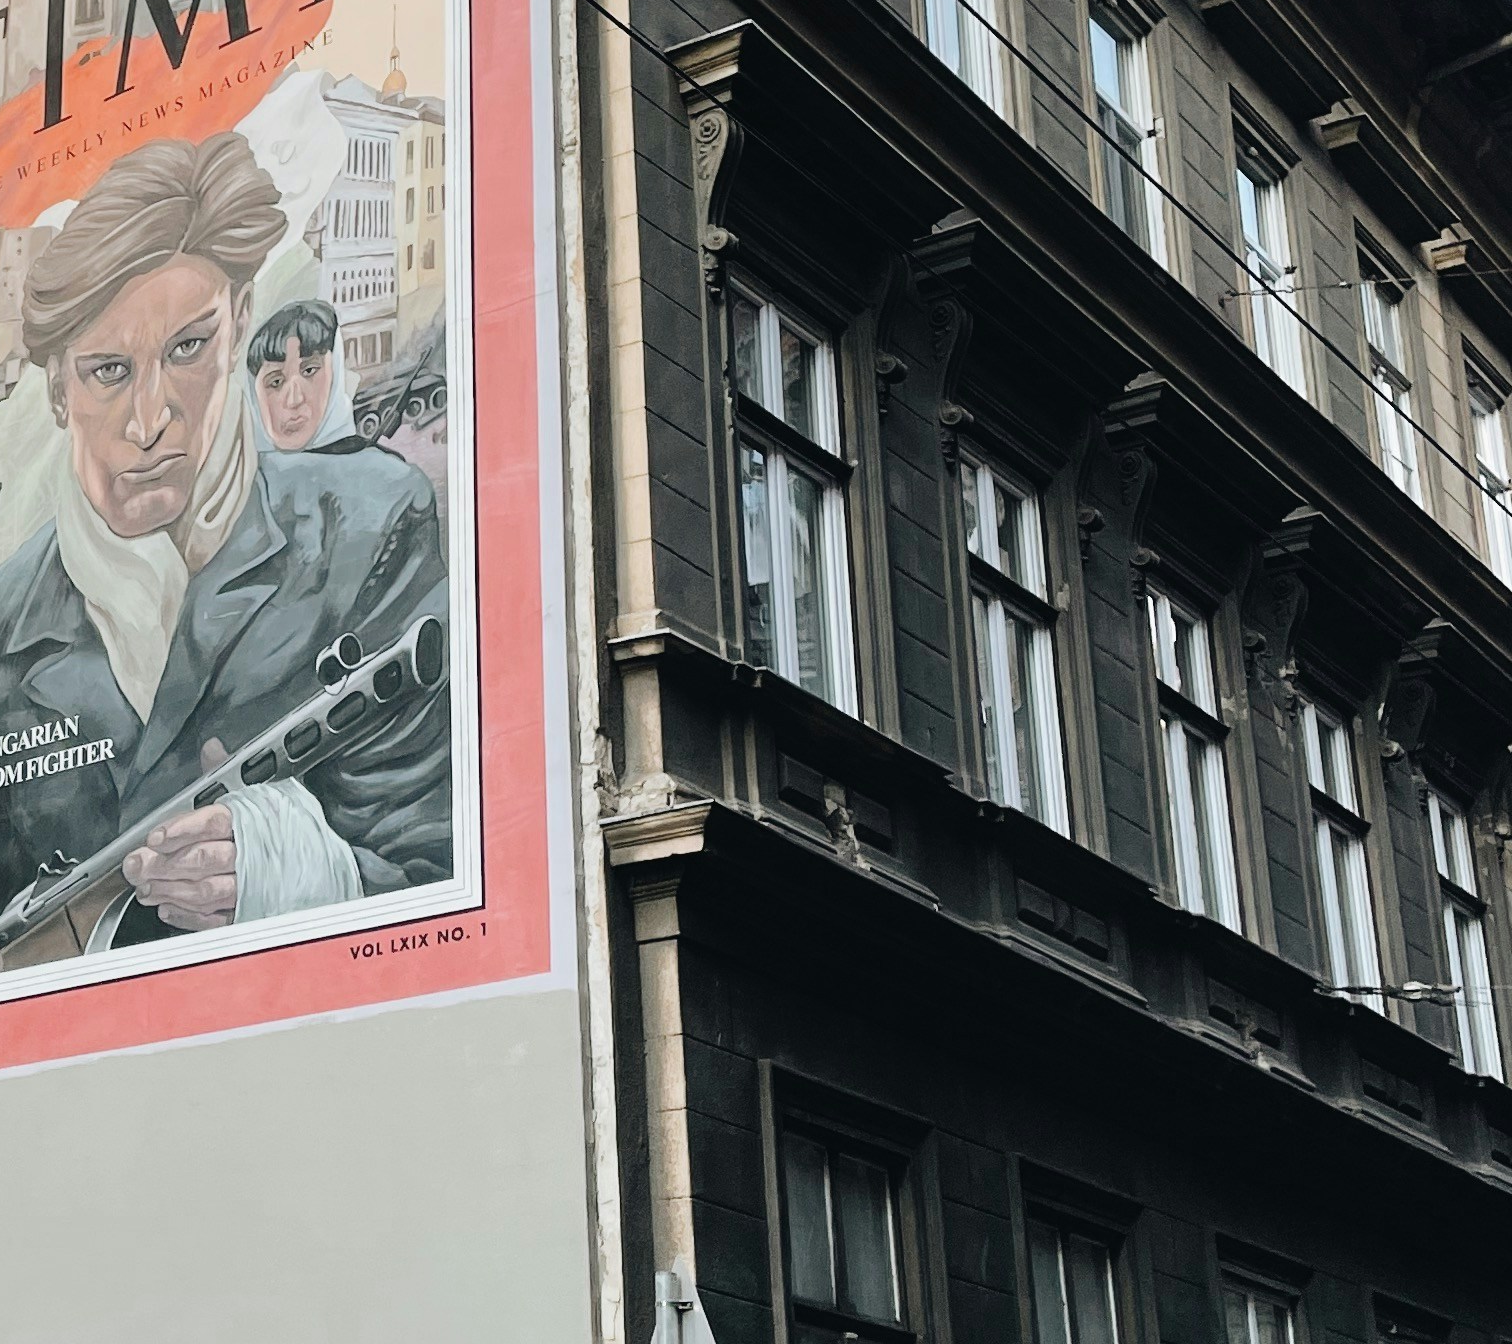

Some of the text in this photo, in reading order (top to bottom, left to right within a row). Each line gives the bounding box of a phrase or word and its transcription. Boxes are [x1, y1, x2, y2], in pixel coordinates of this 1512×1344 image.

[15, 131, 108, 181] WEEKLY
[121, 95, 184, 137] NEWS
[198, 28, 334, 102] MAGAZINE
[25, 738, 116, 781] FIGHTER
[350, 922, 486, 960] VOL LXIX NO. 1
